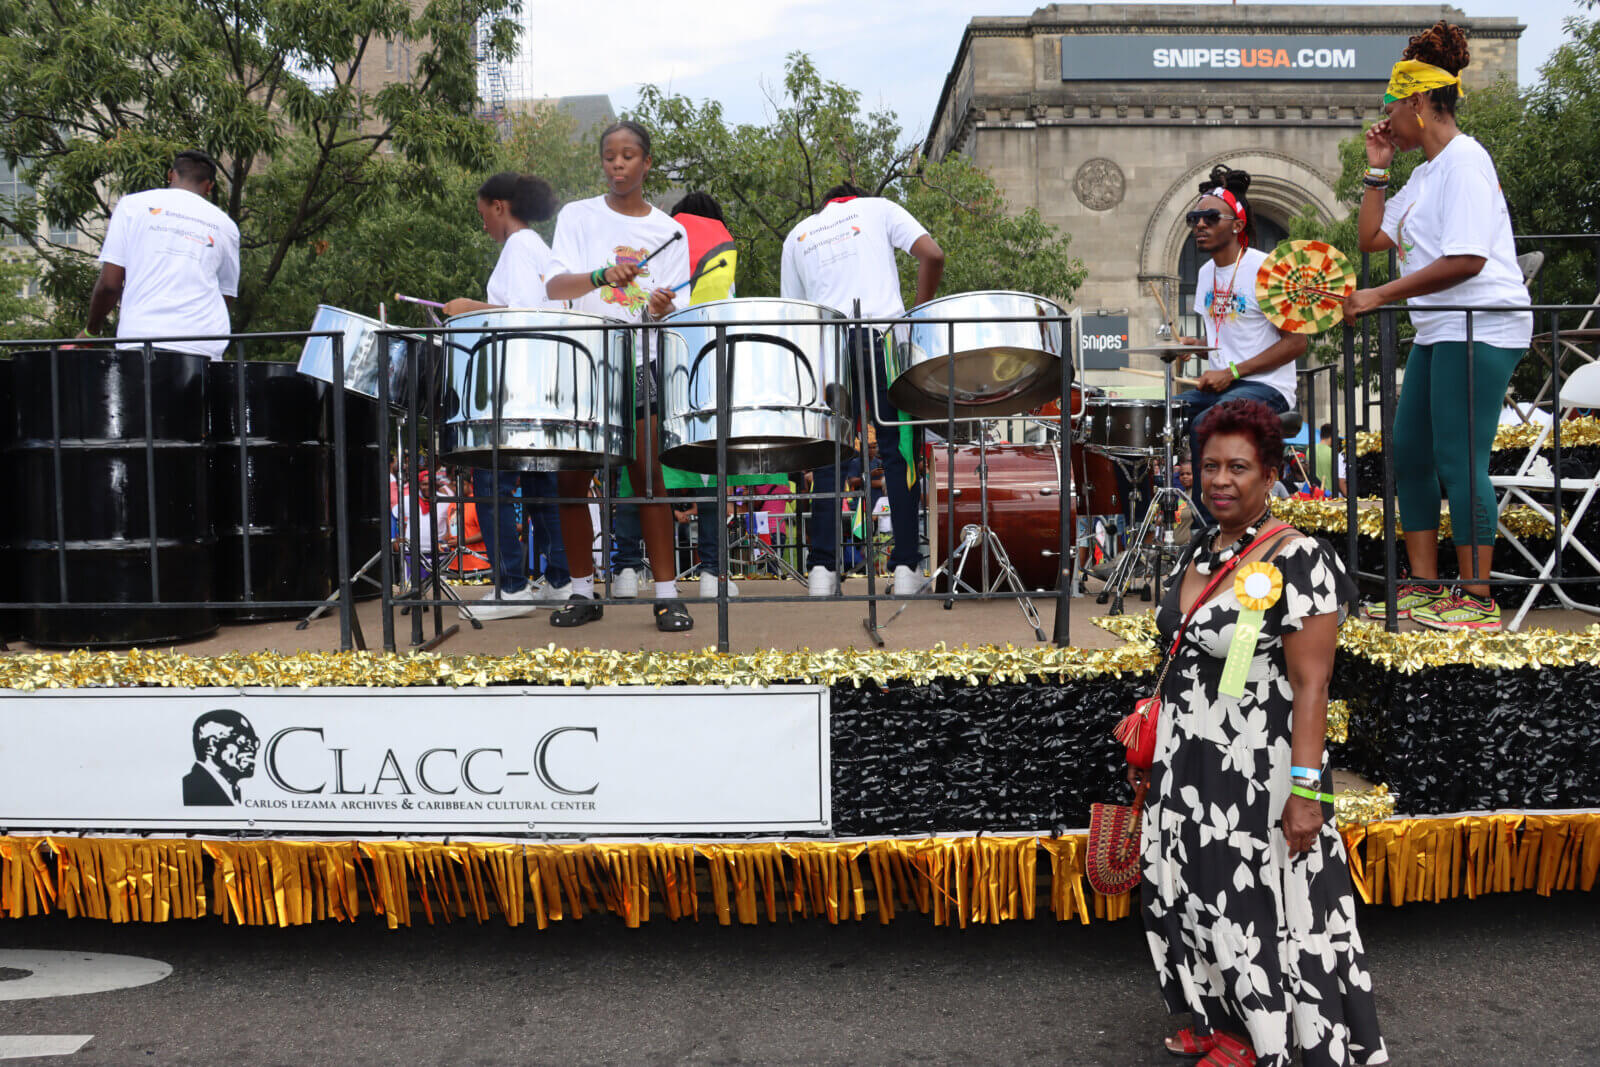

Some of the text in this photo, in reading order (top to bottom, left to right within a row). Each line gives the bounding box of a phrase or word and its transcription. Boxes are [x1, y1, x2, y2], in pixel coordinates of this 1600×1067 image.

[1153, 48, 1356, 68] SNIPESUSA.COM
[1082, 334, 1122, 352] snipes
[244, 798, 596, 811] CARLOS LEZAMA ARCHIVES & CARIBBEAN CULTURAL CENTER
